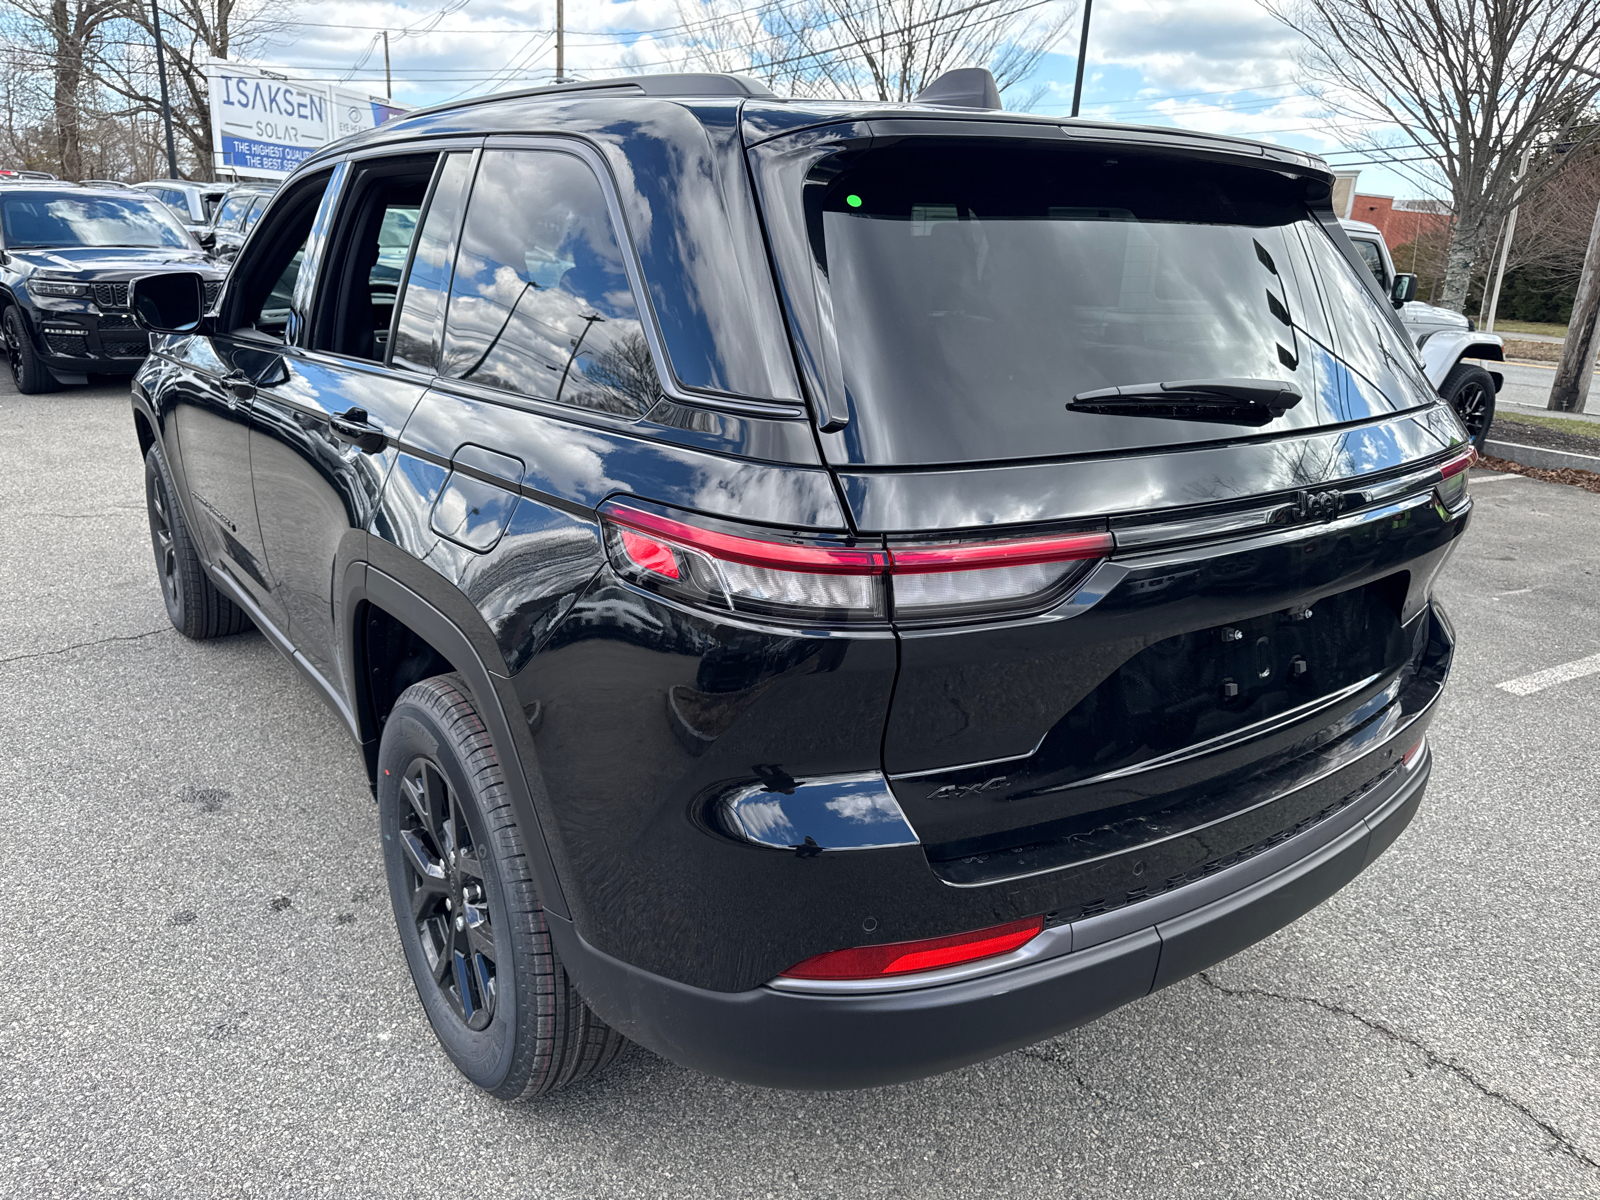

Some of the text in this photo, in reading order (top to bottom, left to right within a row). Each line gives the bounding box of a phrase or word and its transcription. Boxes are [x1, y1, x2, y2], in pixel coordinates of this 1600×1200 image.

[221, 75, 323, 123] ISAKSEN
[256, 120, 299, 143] SOLAR
[233, 141, 250, 154] THE
[251, 143, 284, 159] HIGHEST
[245, 155, 262, 168] THE
[262, 157, 281, 170] BEST
[1292, 489, 1347, 522] Jeep
